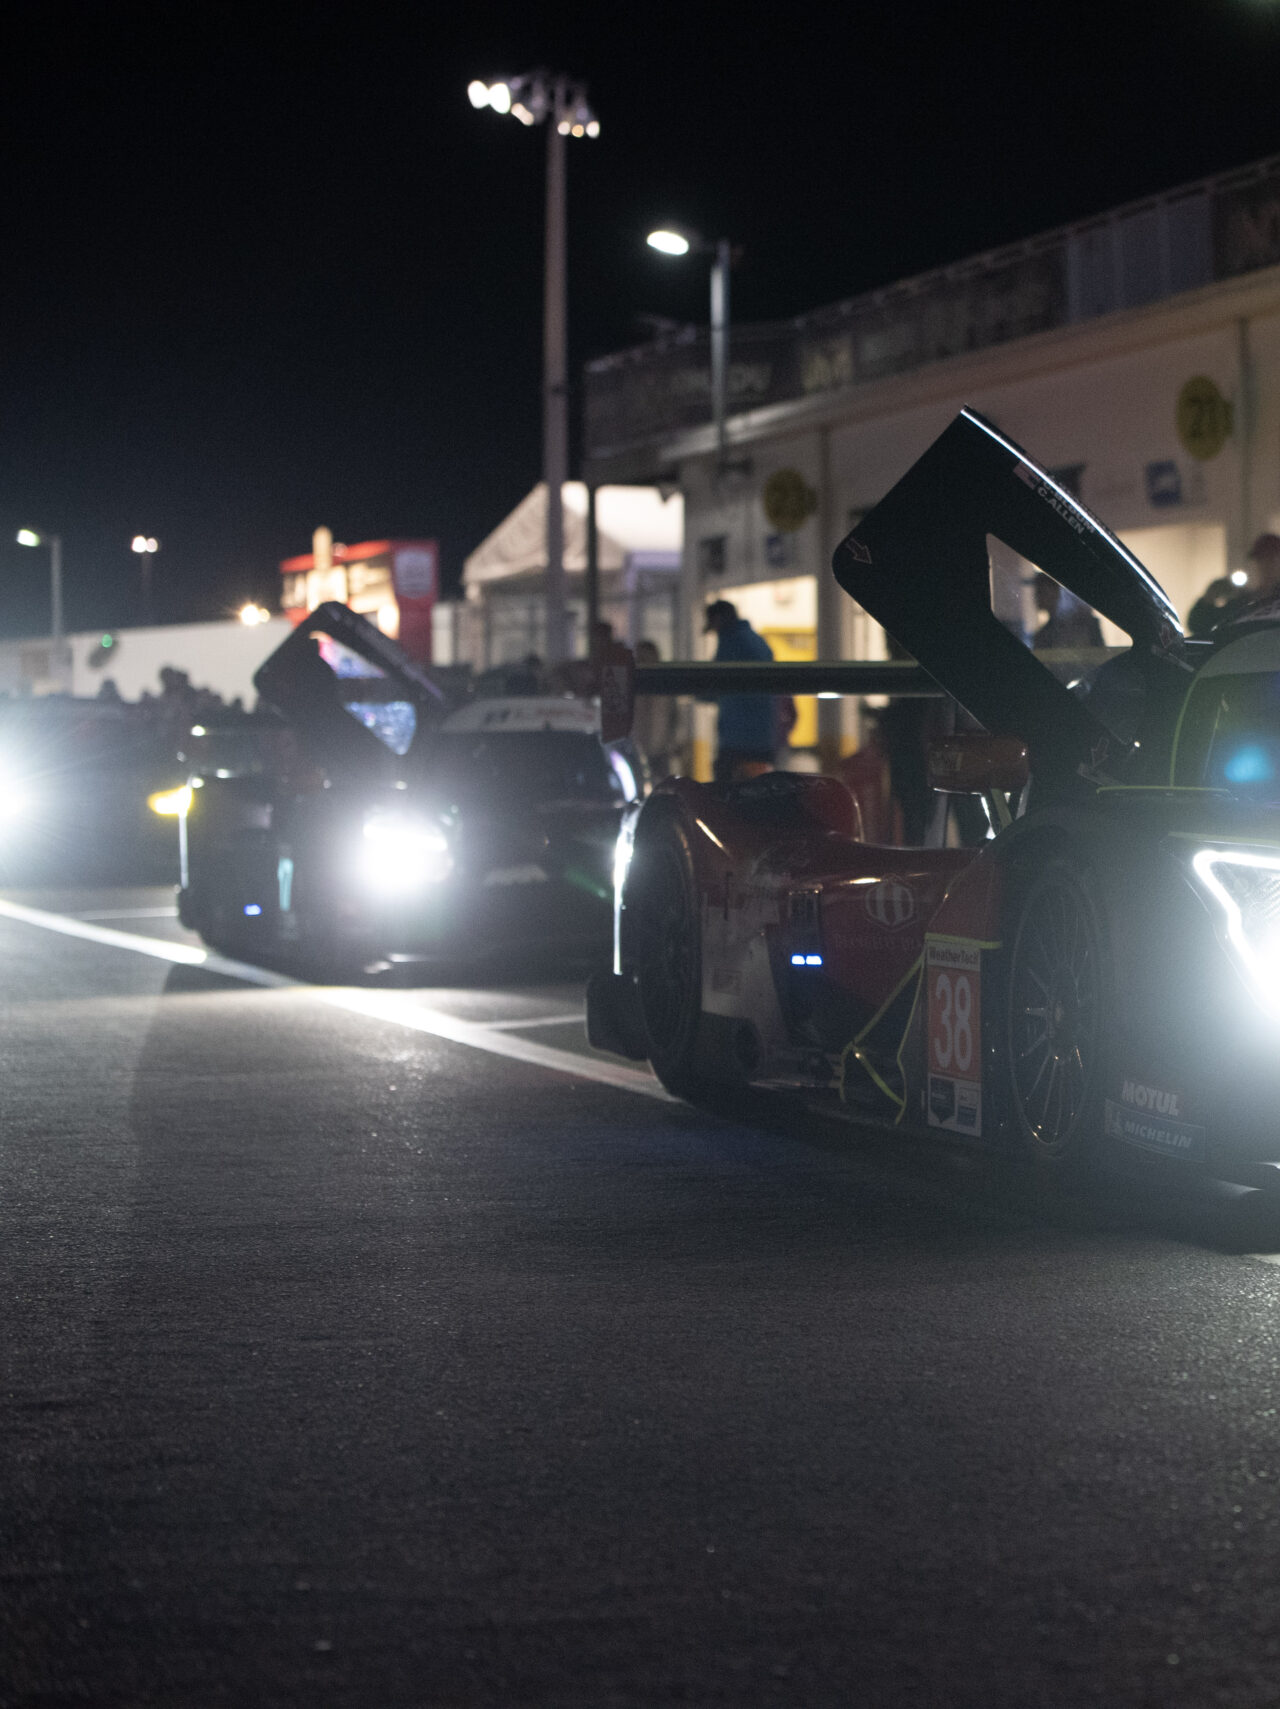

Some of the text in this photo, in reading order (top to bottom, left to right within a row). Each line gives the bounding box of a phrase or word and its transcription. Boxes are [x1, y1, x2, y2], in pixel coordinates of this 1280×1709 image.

[1037, 486, 1086, 534] C.ALLEN
[929, 946, 979, 965] WeatherTech
[934, 973, 973, 1072] 38
[1121, 1079, 1180, 1117] MOTUL
[1124, 1120, 1193, 1149] MICHELIN
